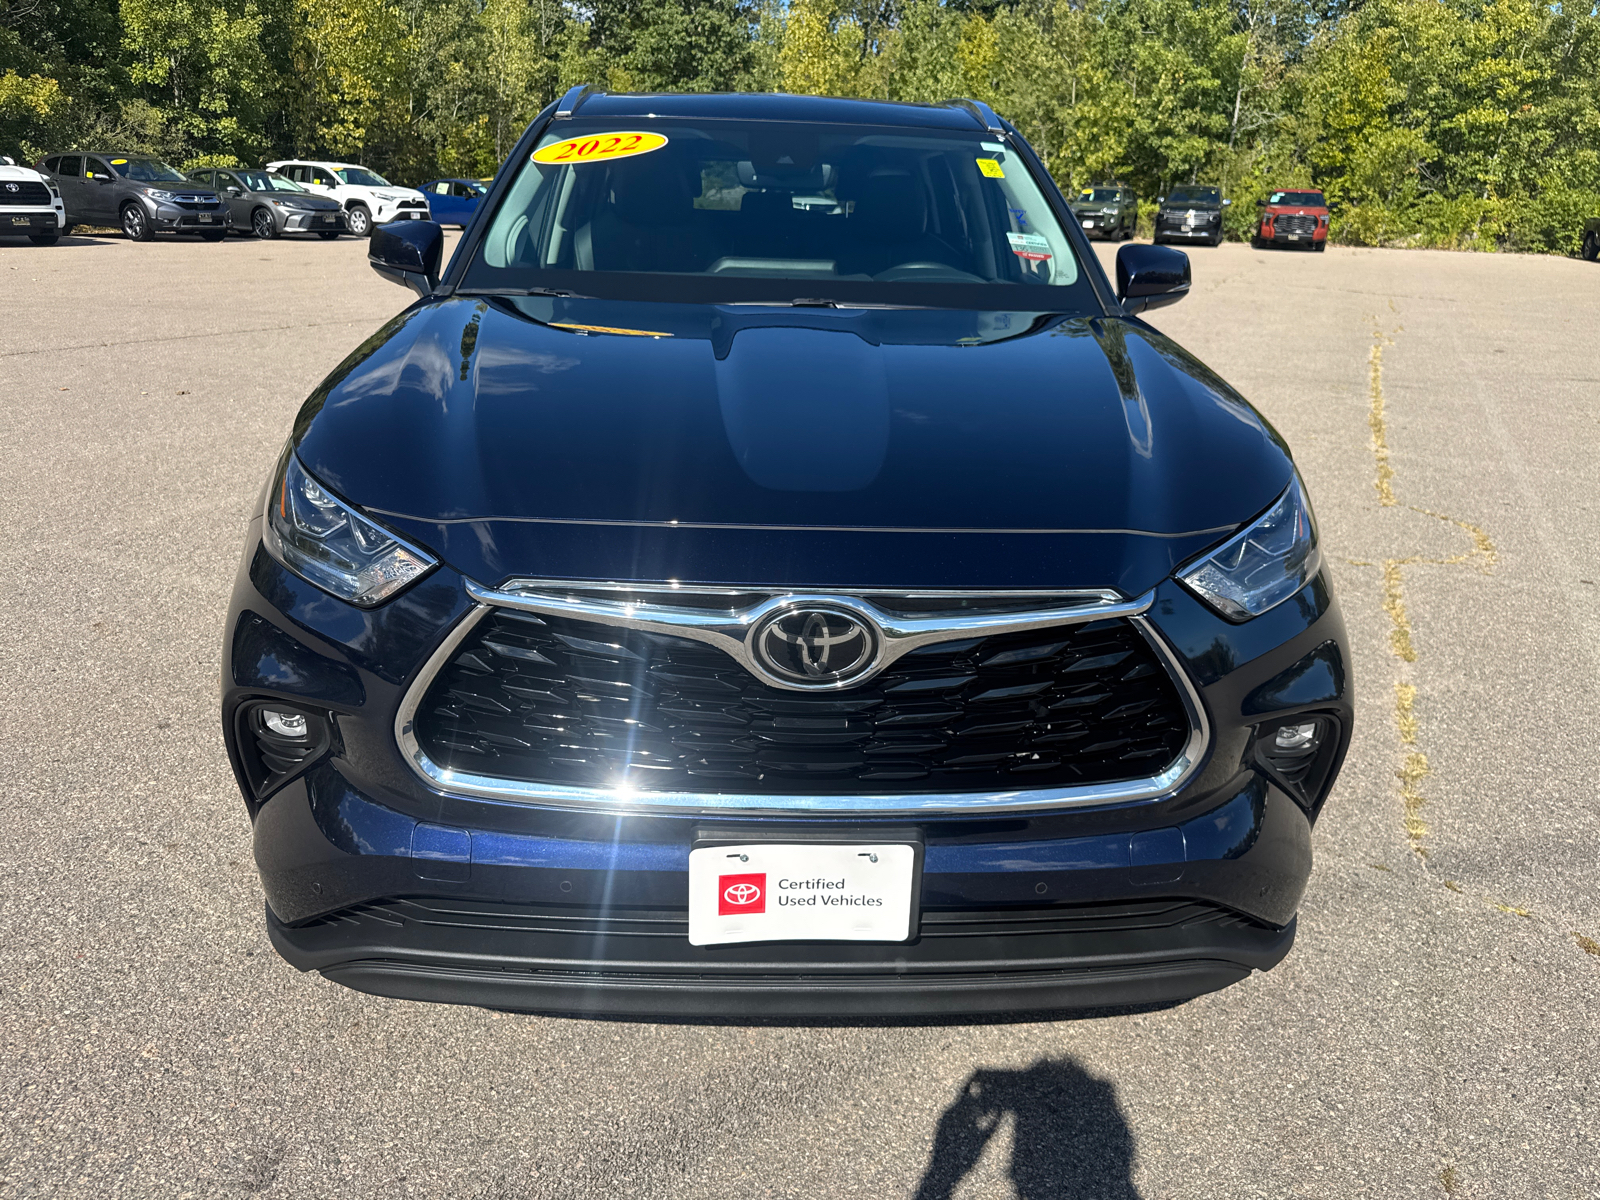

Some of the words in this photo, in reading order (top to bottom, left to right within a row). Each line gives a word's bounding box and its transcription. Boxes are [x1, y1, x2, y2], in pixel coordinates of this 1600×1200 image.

[553, 135, 642, 160] 2022
[778, 878, 845, 890] Certified
[778, 895, 816, 907] Used
[821, 895, 883, 907] Vehicles
